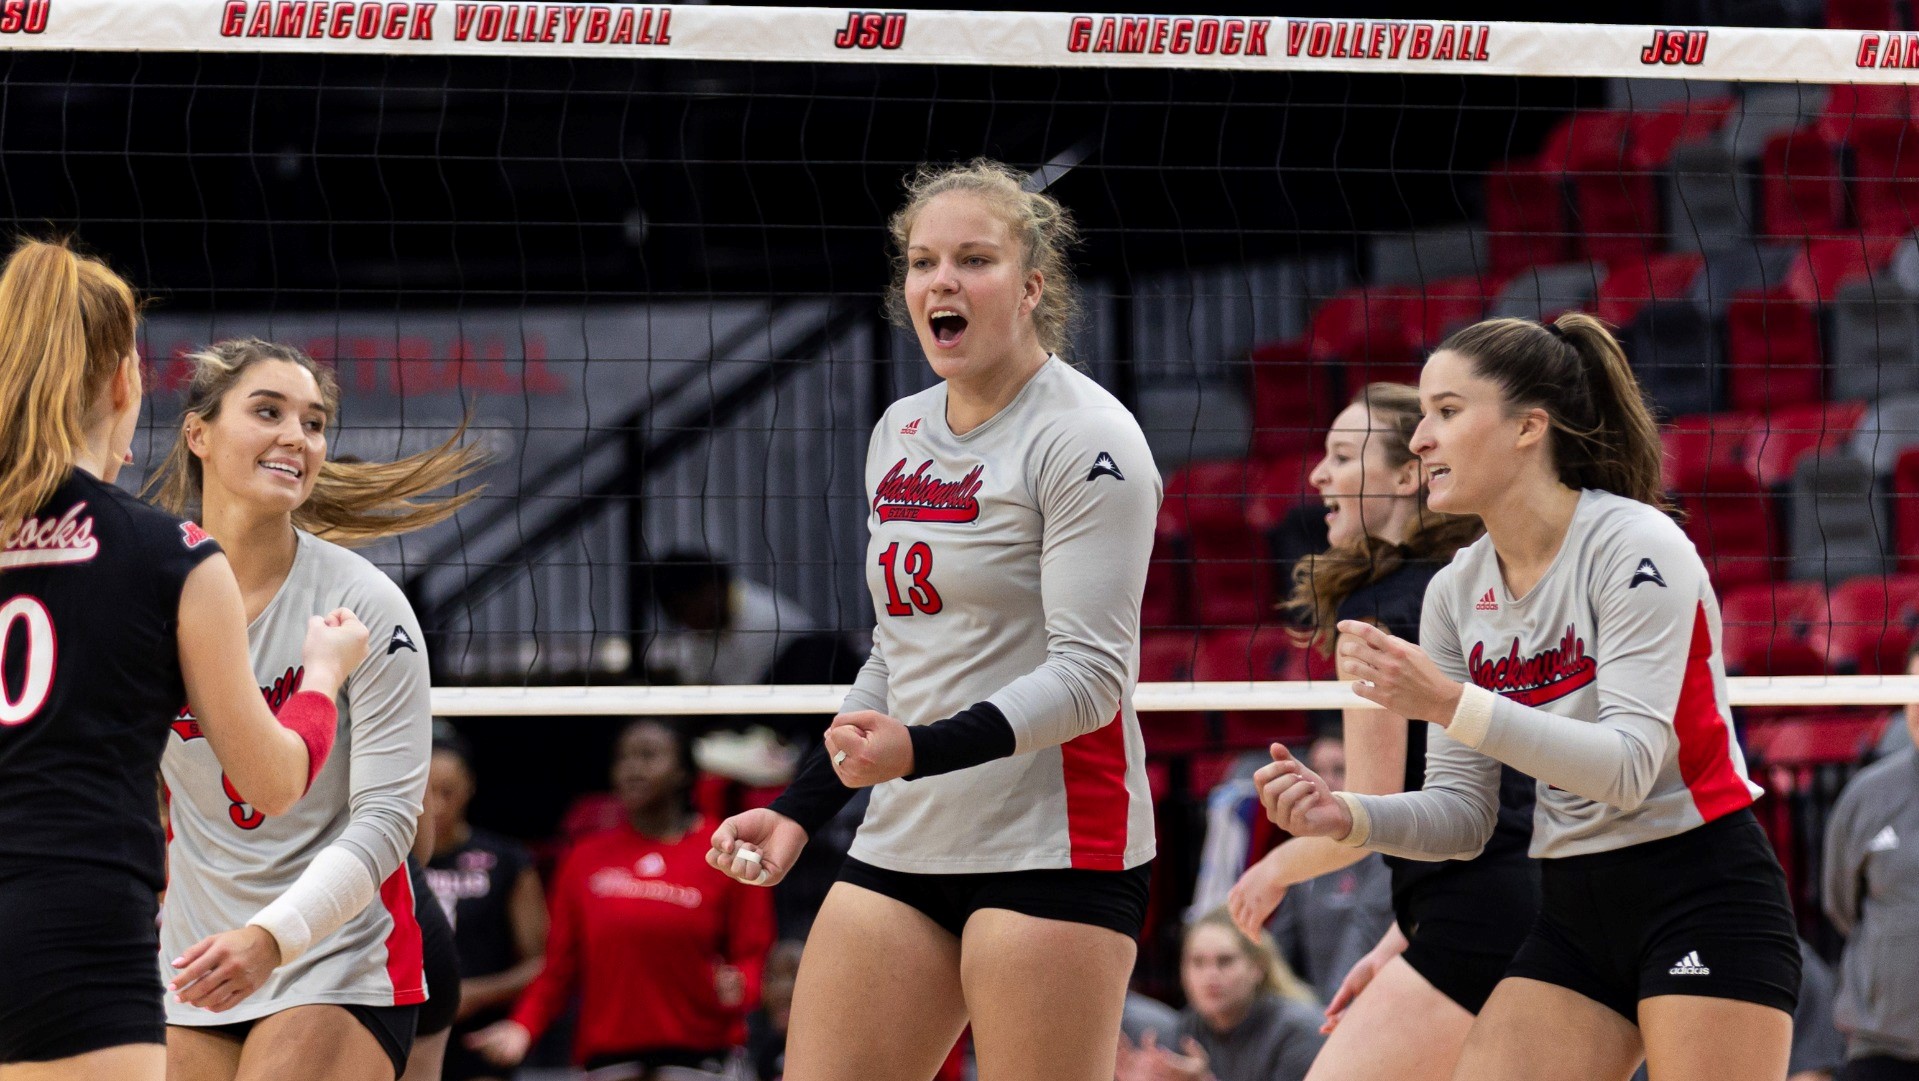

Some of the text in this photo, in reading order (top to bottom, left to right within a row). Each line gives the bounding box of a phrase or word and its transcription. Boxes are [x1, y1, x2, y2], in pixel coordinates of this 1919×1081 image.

[220, 0, 673, 46] GAMECOCK VOLLEYBALL
[835, 12, 906, 49] JSU
[1067, 16, 1490, 62] GAMECOCK VOLLEYBALL
[1641, 29, 1709, 65] JSU
[137, 336, 568, 394] ATBALL
[887, 508, 919, 518] STATE
[878, 541, 943, 617] 13
[1476, 602, 1499, 610] adidas
[0, 594, 58, 727] 0
[1669, 966, 1710, 975] adidas
